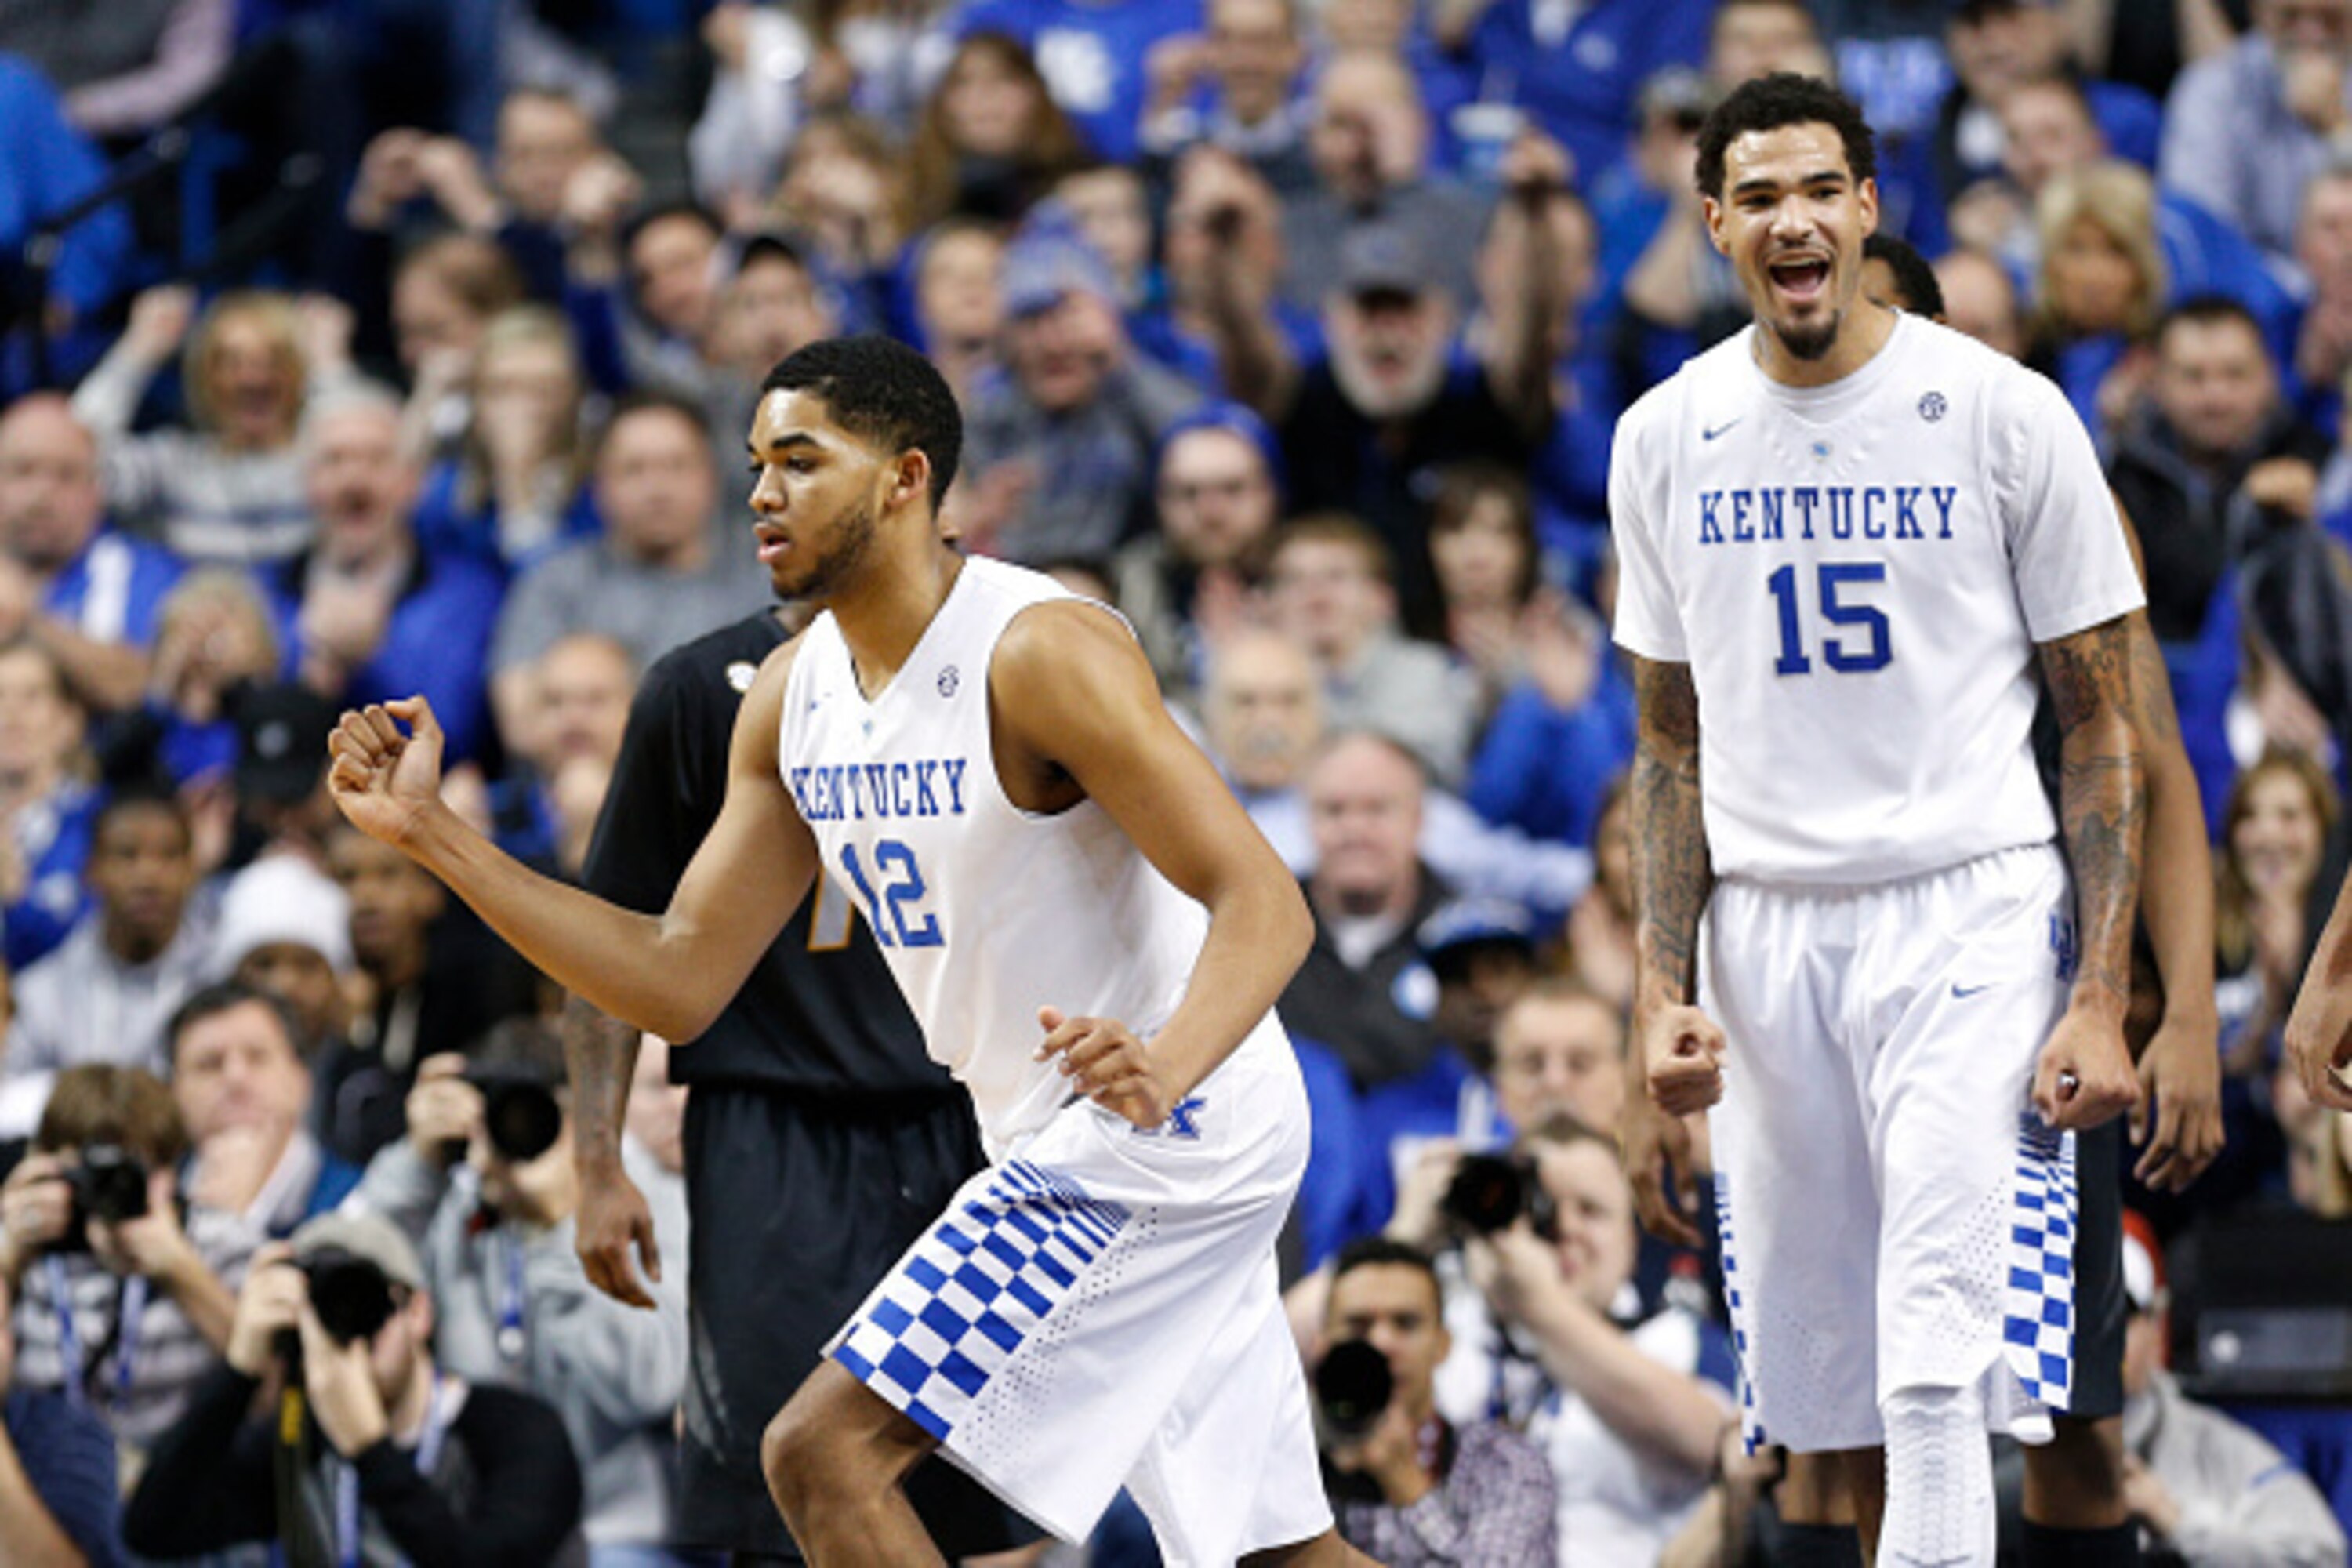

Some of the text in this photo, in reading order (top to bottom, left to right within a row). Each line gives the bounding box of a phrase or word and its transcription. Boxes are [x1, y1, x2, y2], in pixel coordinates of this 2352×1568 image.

[1698, 486, 1958, 544] KENTUCKY
[1767, 562, 1893, 676] 15
[790, 757, 967, 821] KENTUCKY
[840, 838, 946, 947] 12
